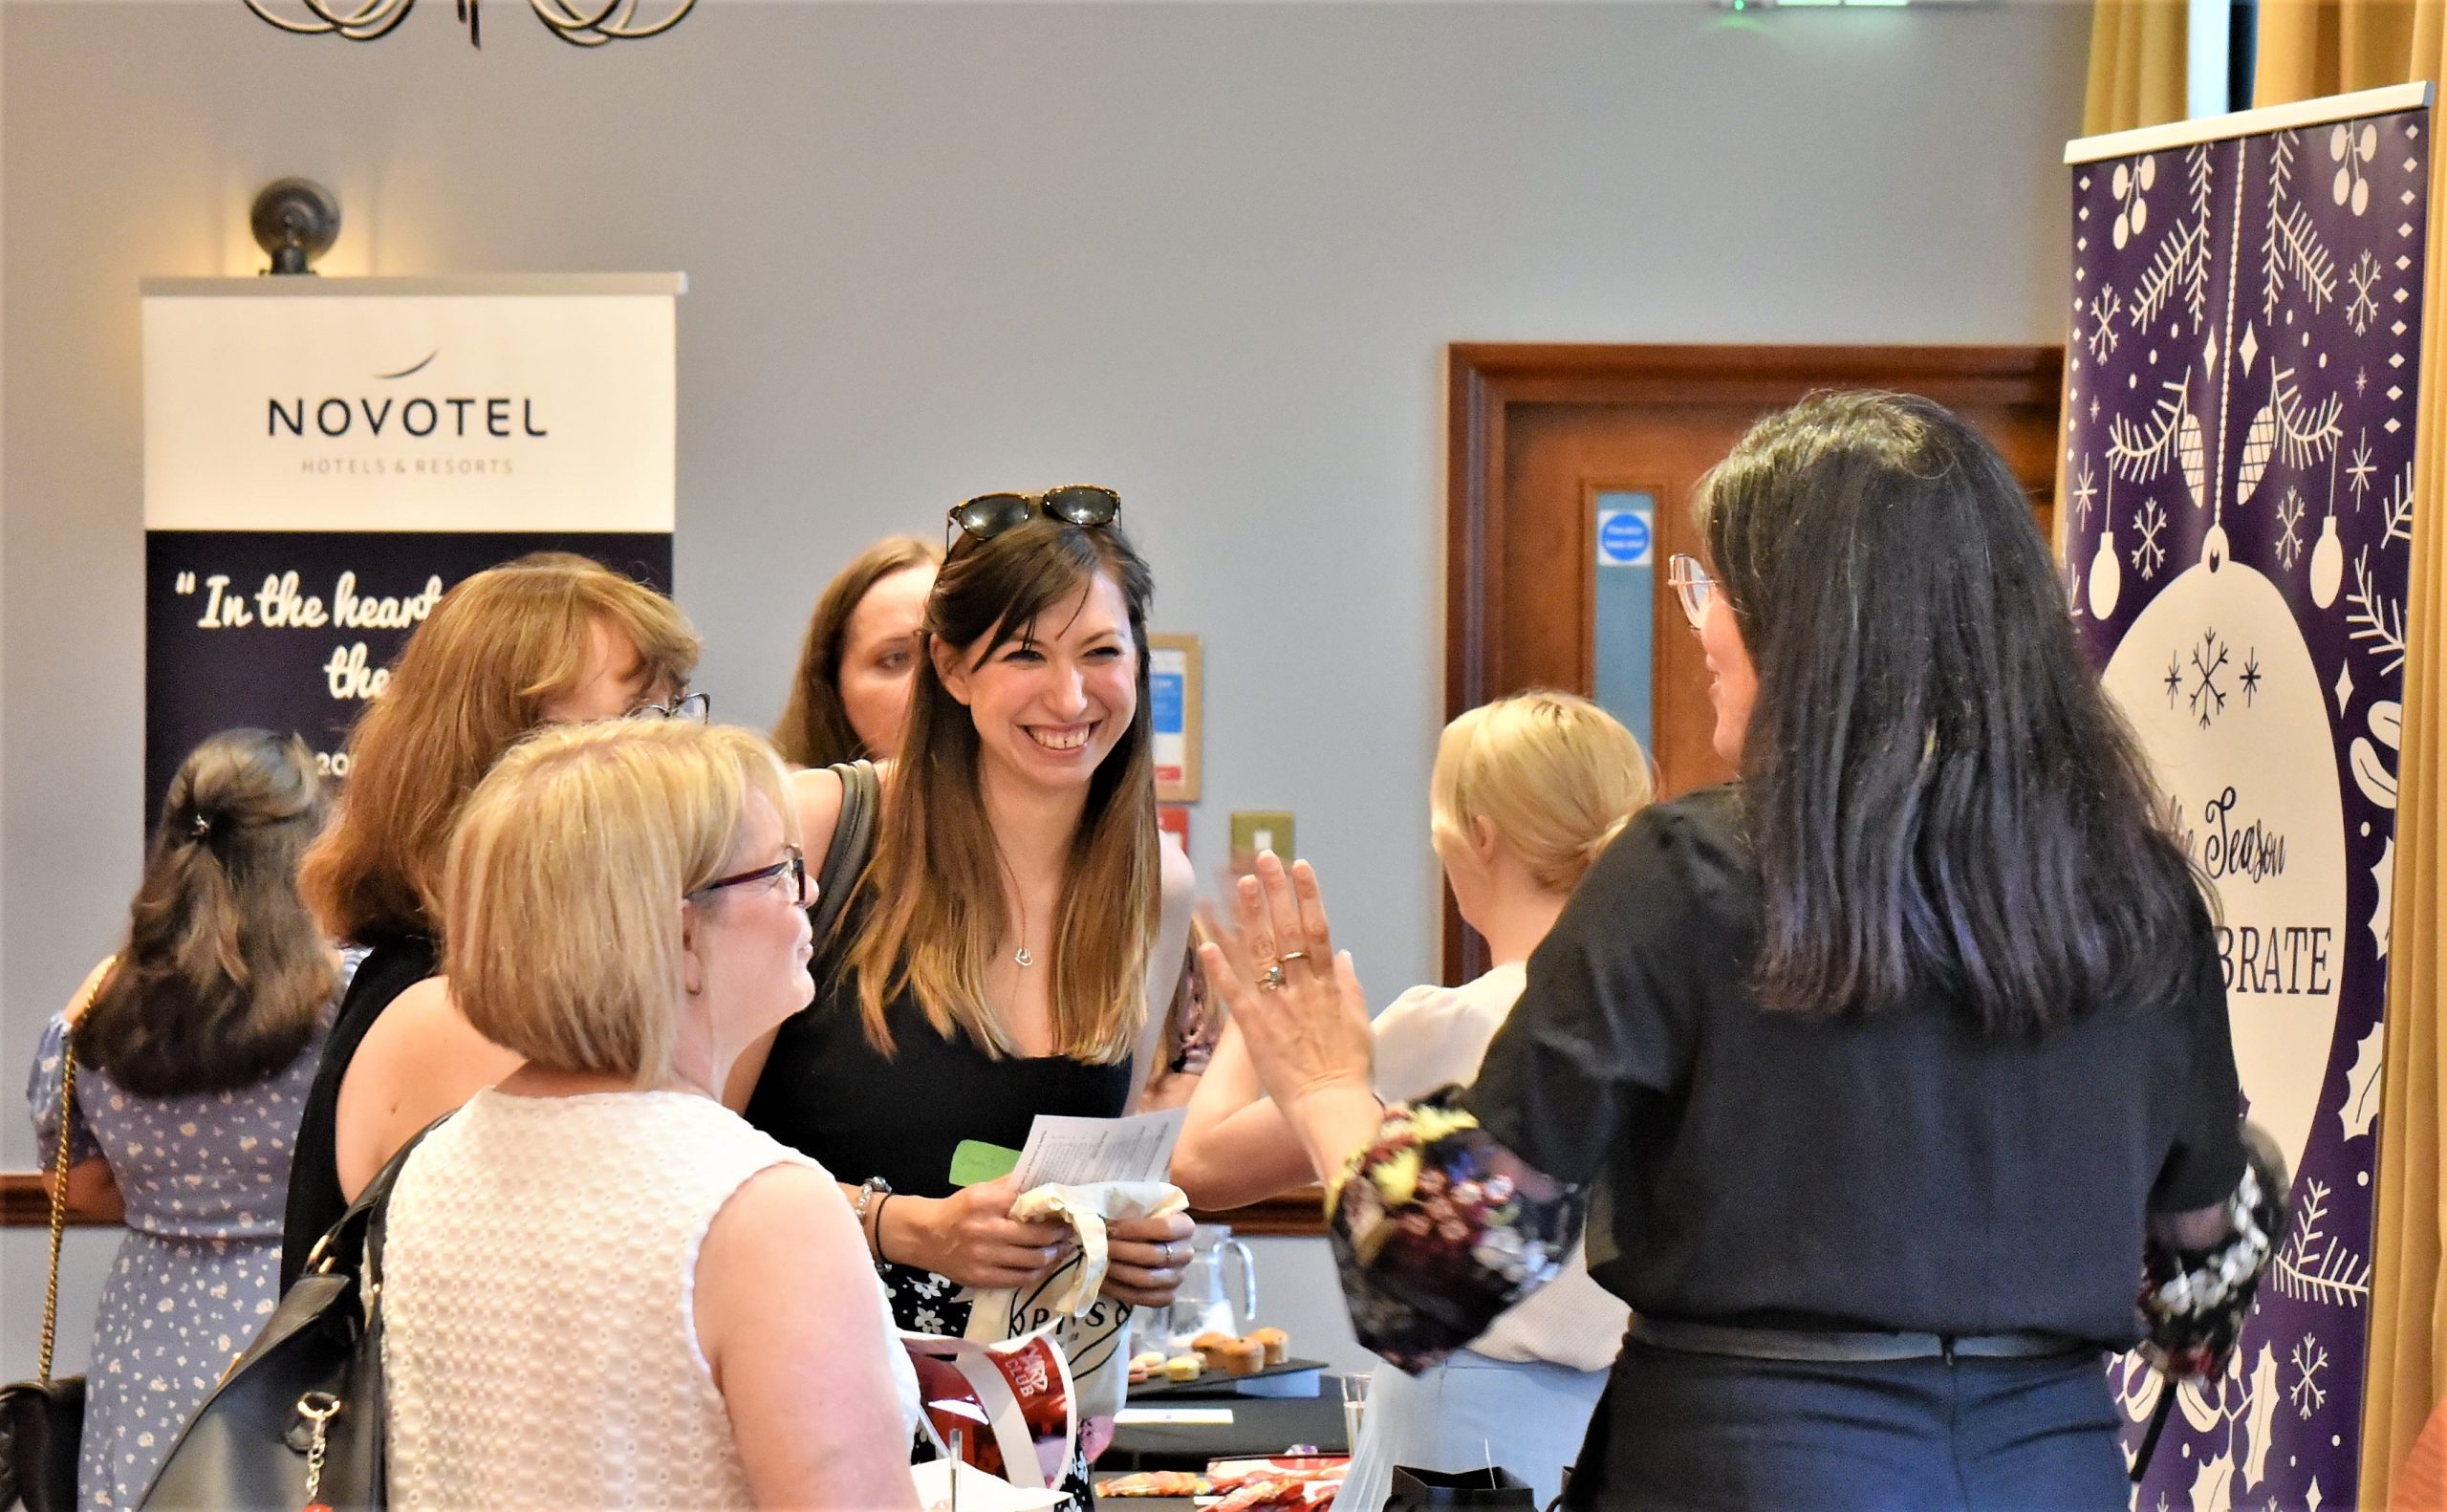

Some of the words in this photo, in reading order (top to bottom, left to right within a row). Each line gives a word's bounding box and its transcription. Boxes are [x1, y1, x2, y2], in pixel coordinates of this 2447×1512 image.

[269, 398, 548, 437] NOVOTEL
[302, 458, 386, 476] HOTELS
[394, 458, 406, 475] &
[416, 458, 514, 476] RESORTS
[254, 570, 329, 628] the
[334, 571, 444, 628] heart
[323, 641, 391, 699] the
[2204, 786, 2286, 884] Season
[2212, 925, 2332, 996] BRATE
[1006, 1358, 1034, 1397] CLUB
